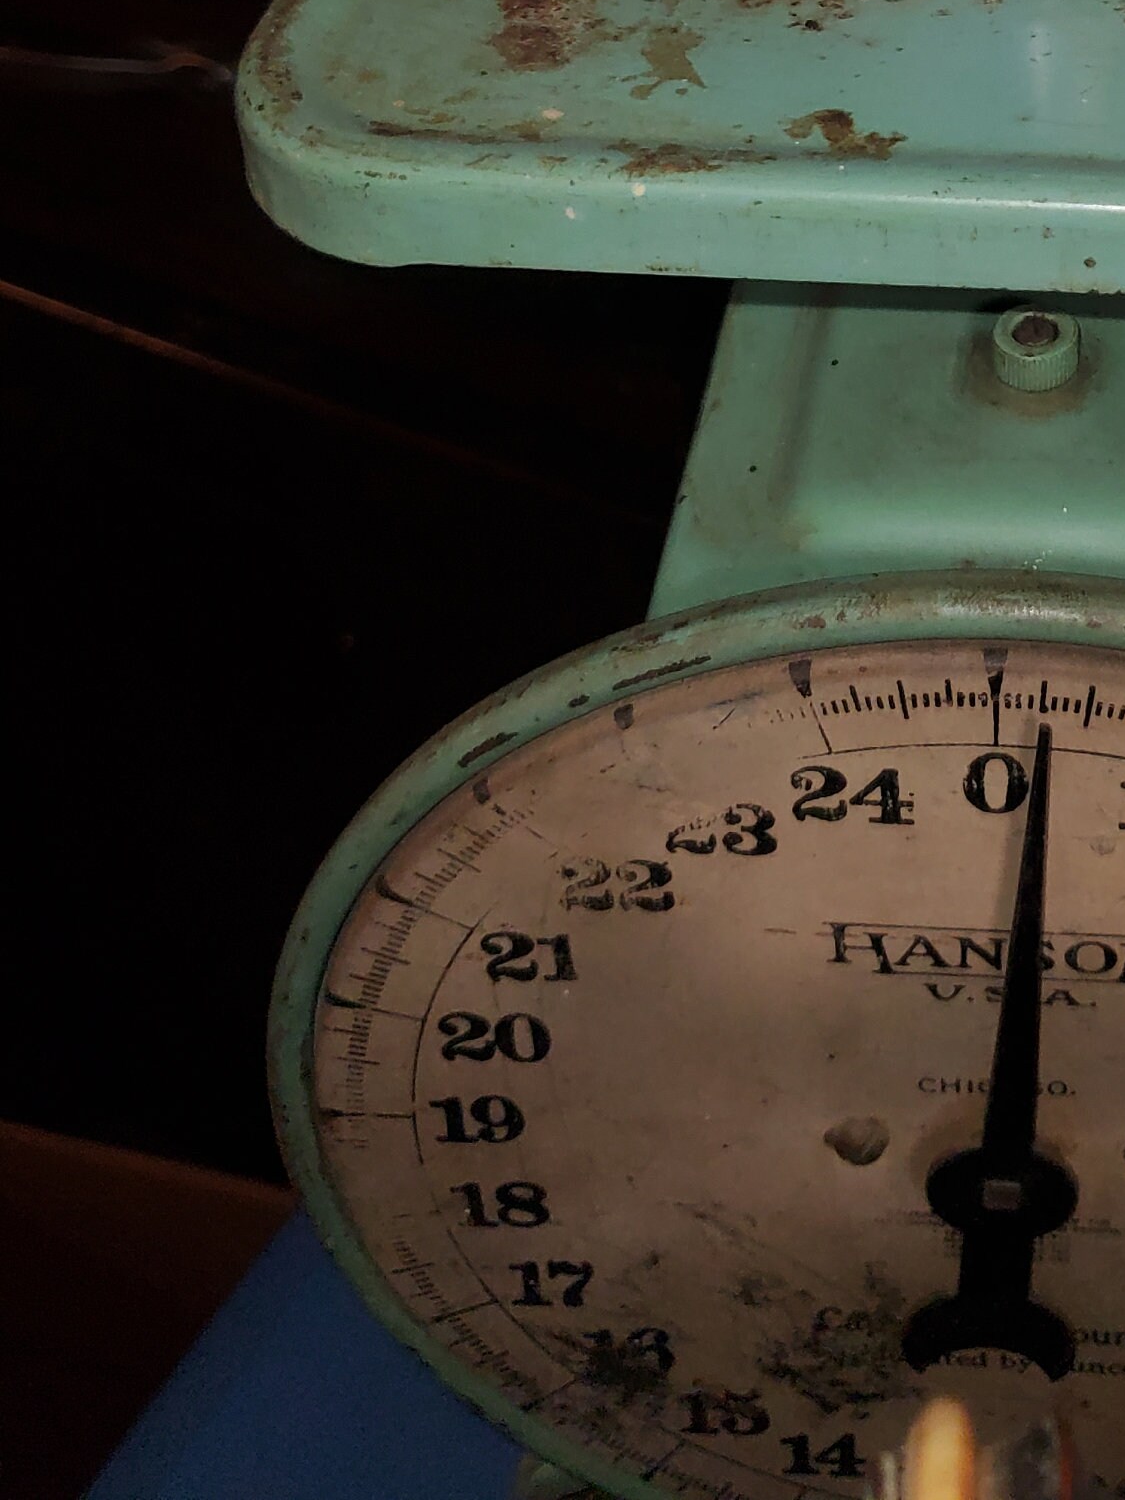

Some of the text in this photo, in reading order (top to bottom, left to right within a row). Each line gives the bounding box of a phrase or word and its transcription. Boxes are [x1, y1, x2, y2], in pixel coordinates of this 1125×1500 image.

[790, 765, 914, 825] 24
[962, 753, 1030, 814] 0
[666, 803, 779, 856] 23
[559, 857, 677, 912] 22
[480, 930, 579, 983] 21
[438, 1011, 552, 1064] 20
[428, 1094, 526, 1144] 19
[449, 1181, 551, 1228] 18
[508, 1260, 594, 1307] 17
[679, 1387, 771, 1435] 15
[780, 1432, 866, 1478] 14
